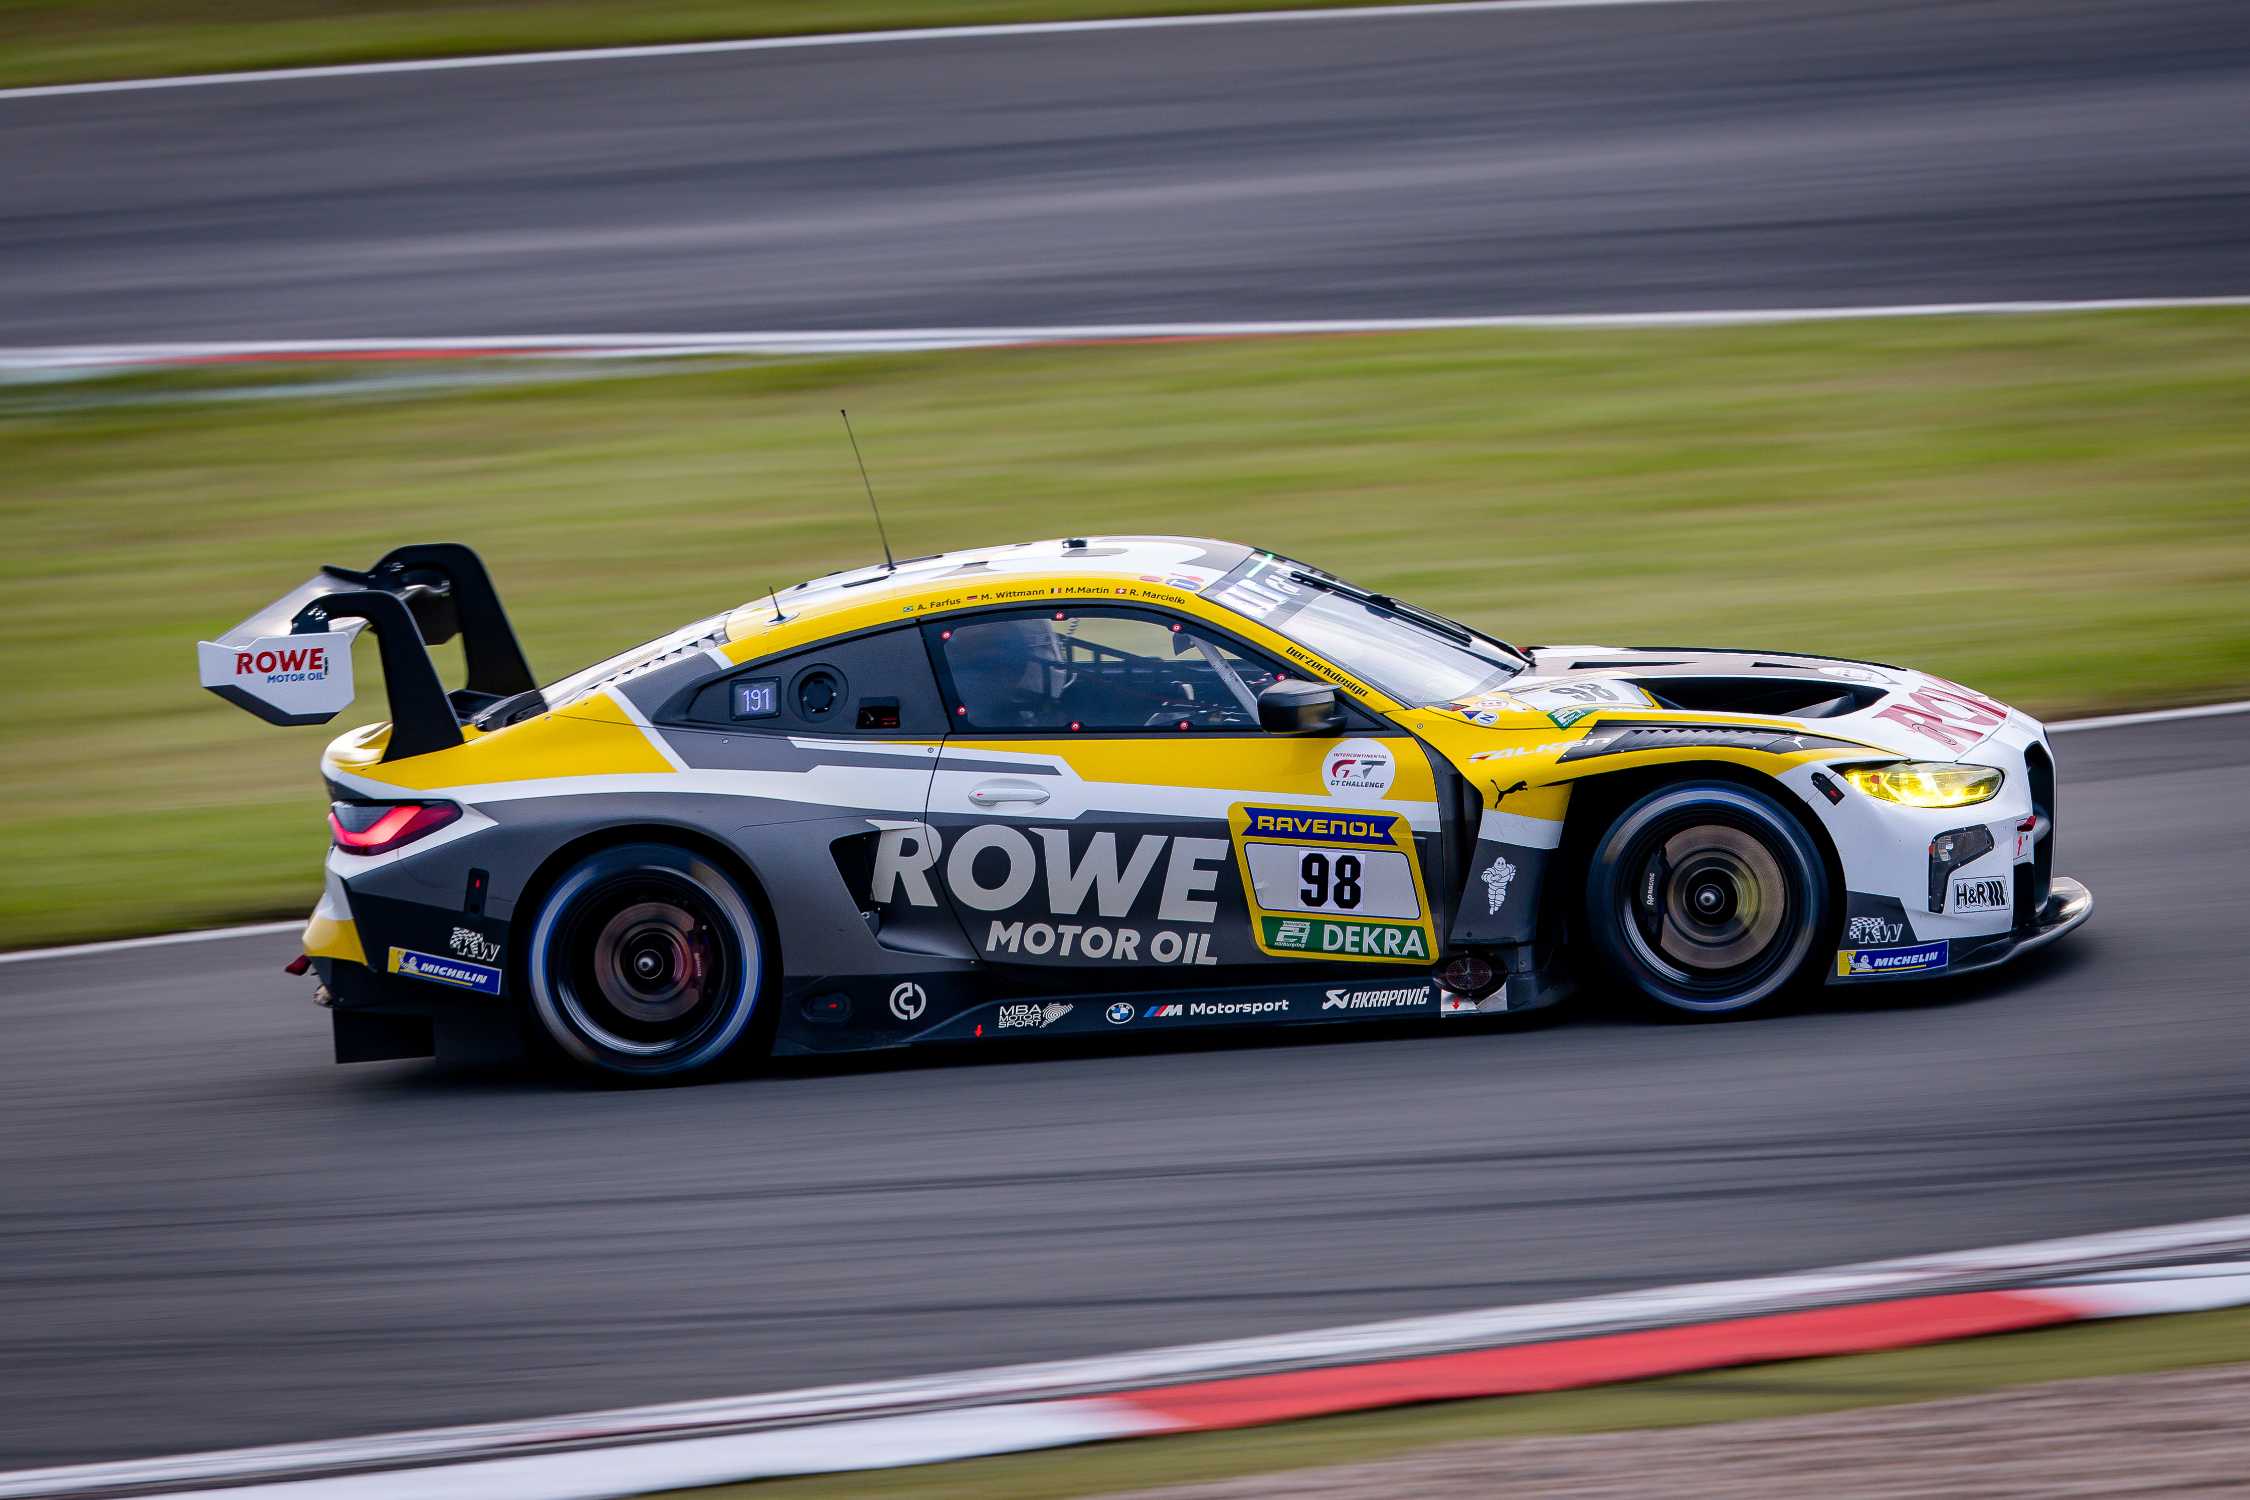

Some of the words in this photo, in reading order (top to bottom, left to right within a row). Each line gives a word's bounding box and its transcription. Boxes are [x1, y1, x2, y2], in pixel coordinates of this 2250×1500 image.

[930, 598, 961, 609] Farfus
[981, 593, 993, 601] M.
[996, 589, 1045, 599] Wittmann
[1129, 588, 1140, 597] R.
[1142, 590, 1185, 605] Marciello
[233, 648, 324, 675] ROWE
[267, 672, 305, 684] MOTOR
[308, 672, 325, 681] OIL
[743, 687, 770, 712] 191
[1330, 779, 1340, 787] GT
[1341, 780, 1385, 789] CHALLENGE
[1257, 815, 1384, 838] RAVENOL
[865, 819, 1230, 923] ROWE
[1300, 852, 1362, 910] 98
[1956, 882, 1988, 906] H&R
[985, 920, 1141, 961] MOTOR
[1150, 930, 1218, 966] OIL
[1322, 923, 1425, 957] DEKRA
[1858, 923, 1904, 944] KW
[457, 938, 501, 962] KW
[1874, 951, 1938, 967] MICHELIN
[420, 962, 488, 984] MICHELIN
[999, 1014, 1041, 1022] MOTOR
[1000, 1004, 1041, 1015] MBA
[1190, 999, 1290, 1017] Motorsport
[998, 1020, 1041, 1028] SPORT
